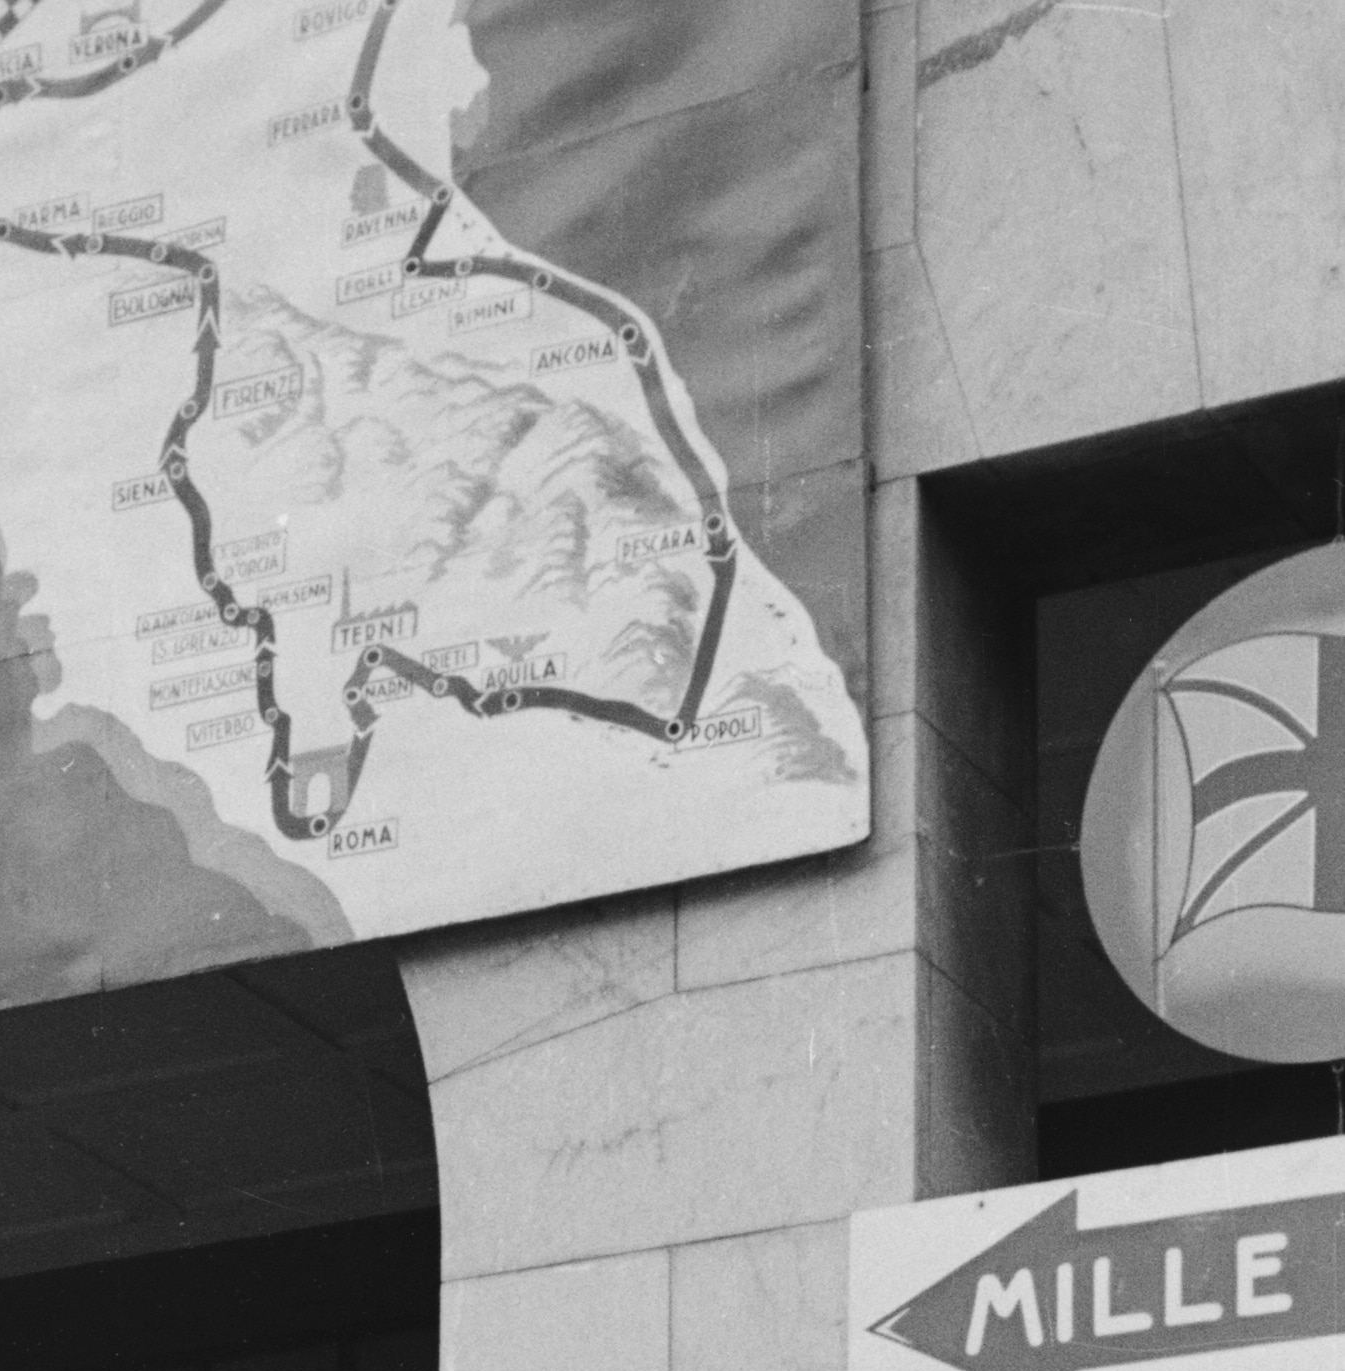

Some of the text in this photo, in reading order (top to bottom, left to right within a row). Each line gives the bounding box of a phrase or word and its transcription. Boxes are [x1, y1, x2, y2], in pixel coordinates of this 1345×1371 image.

[72, 29, 142, 60] VERONA
[273, 104, 341, 140] FERRARA
[17, 202, 81, 228] PARMA
[98, 203, 155, 229] REGGIO
[345, 207, 419, 241] RAVENNA
[113, 282, 195, 320] BOLOGNA
[454, 298, 516, 326] RIMINI
[536, 339, 615, 371] ANCONA
[223, 371, 300, 410] FIRENZE
[118, 480, 169, 504] SIENA
[621, 528, 697, 561] PESCARA
[340, 617, 404, 649] TERNI
[485, 658, 557, 690] AQUILA
[191, 713, 255, 743] VITERBO
[332, 823, 394, 854] ROMA
[964, 1231, 1295, 1357] MILLE
